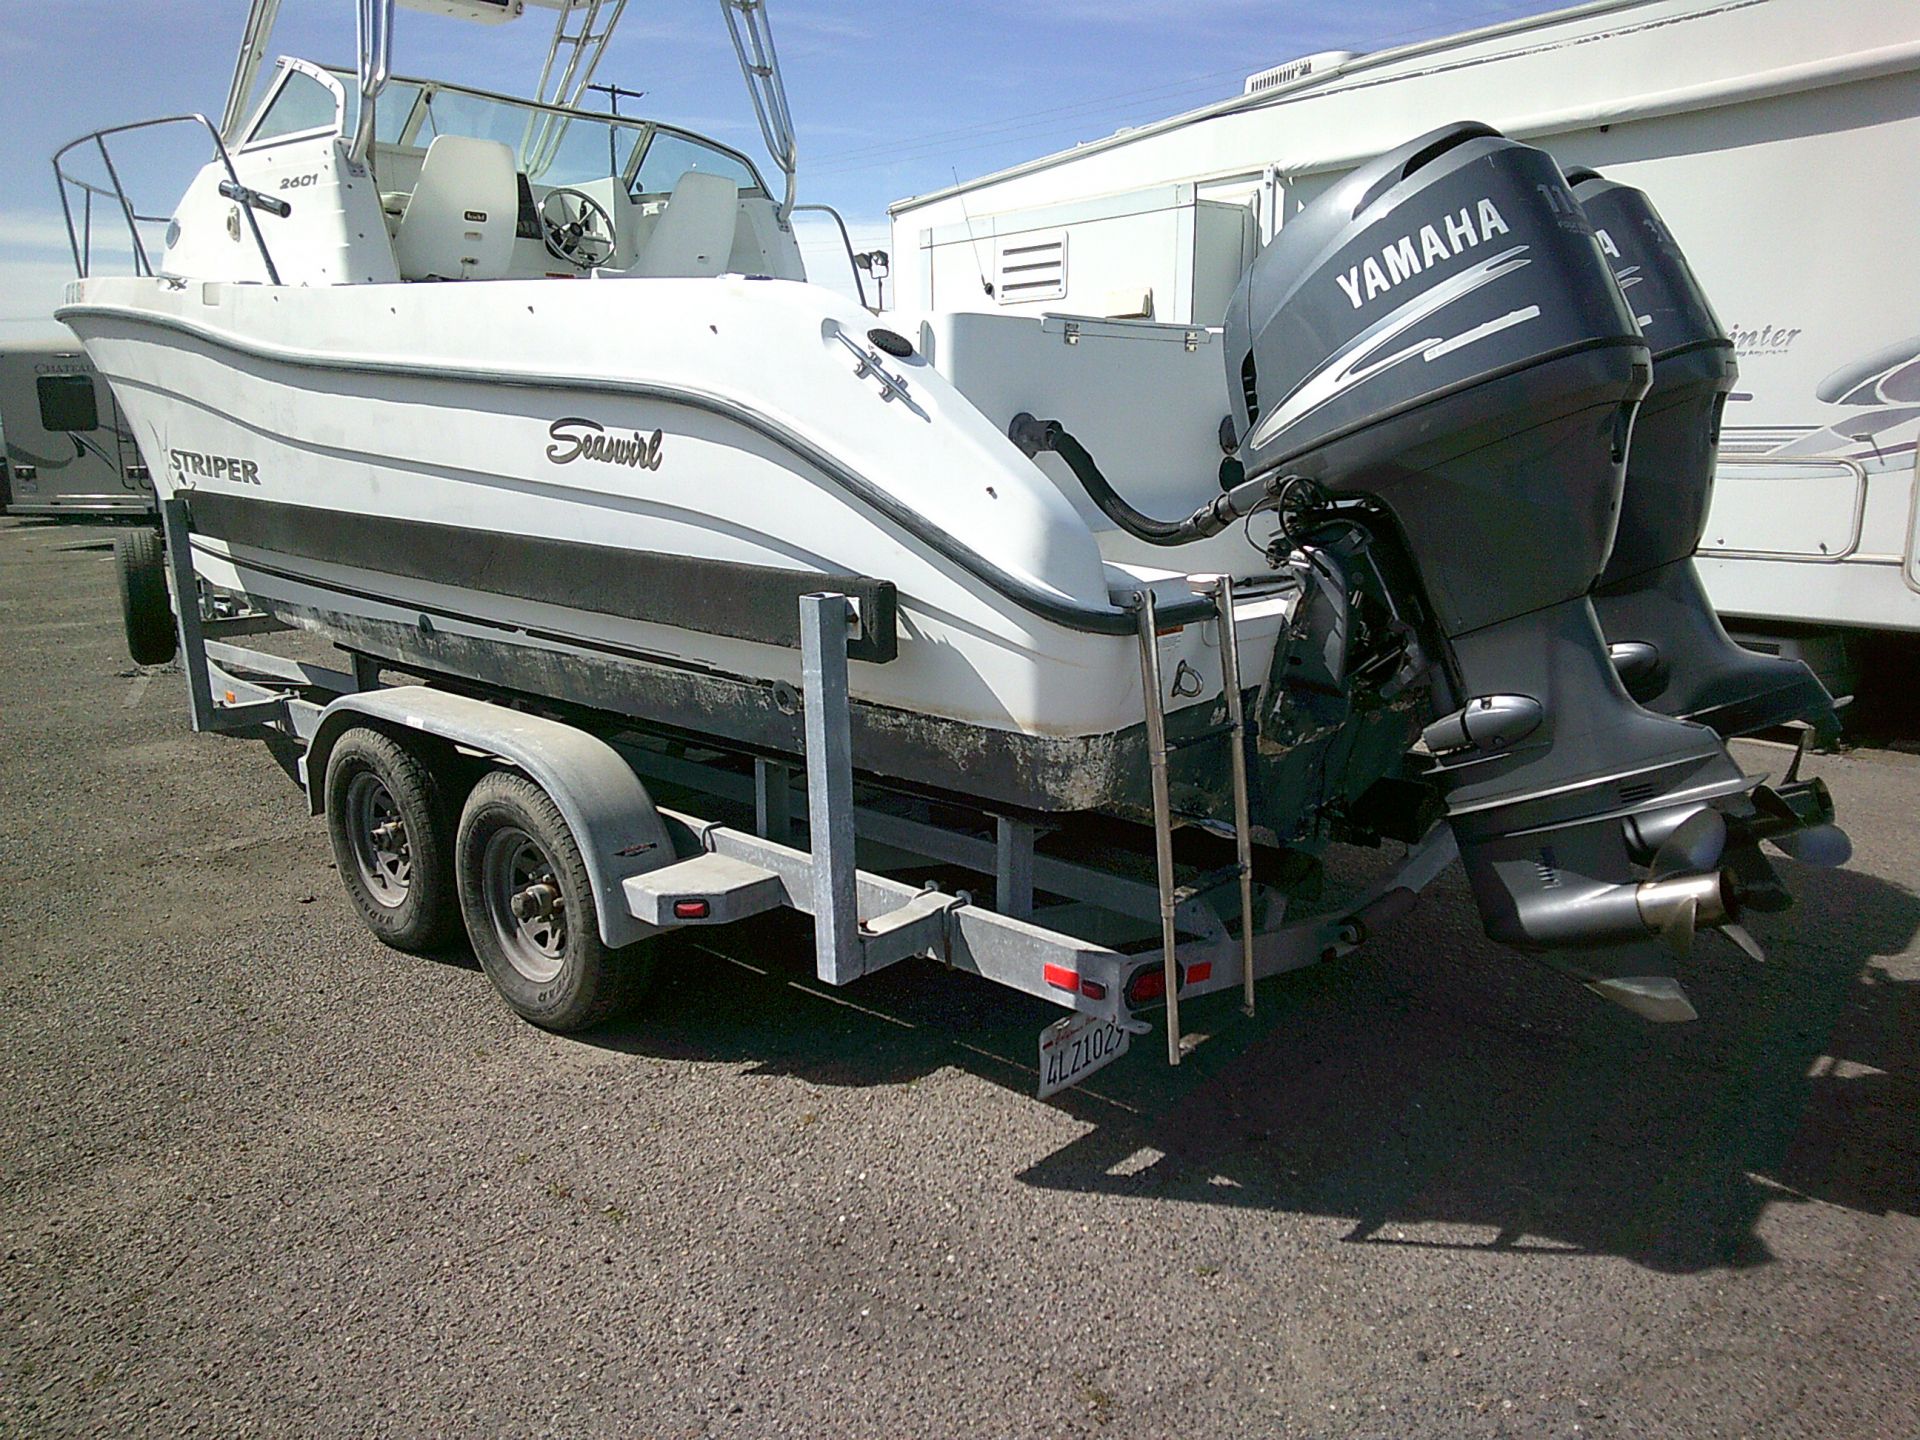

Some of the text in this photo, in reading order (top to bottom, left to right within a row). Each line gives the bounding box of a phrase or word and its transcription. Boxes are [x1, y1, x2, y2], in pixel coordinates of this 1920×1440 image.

[280, 173, 318, 190] 2601
[1335, 198, 1510, 309] YAMAHA
[546, 417, 663, 471] Seaswirl
[170, 449, 262, 485] STRIPER
